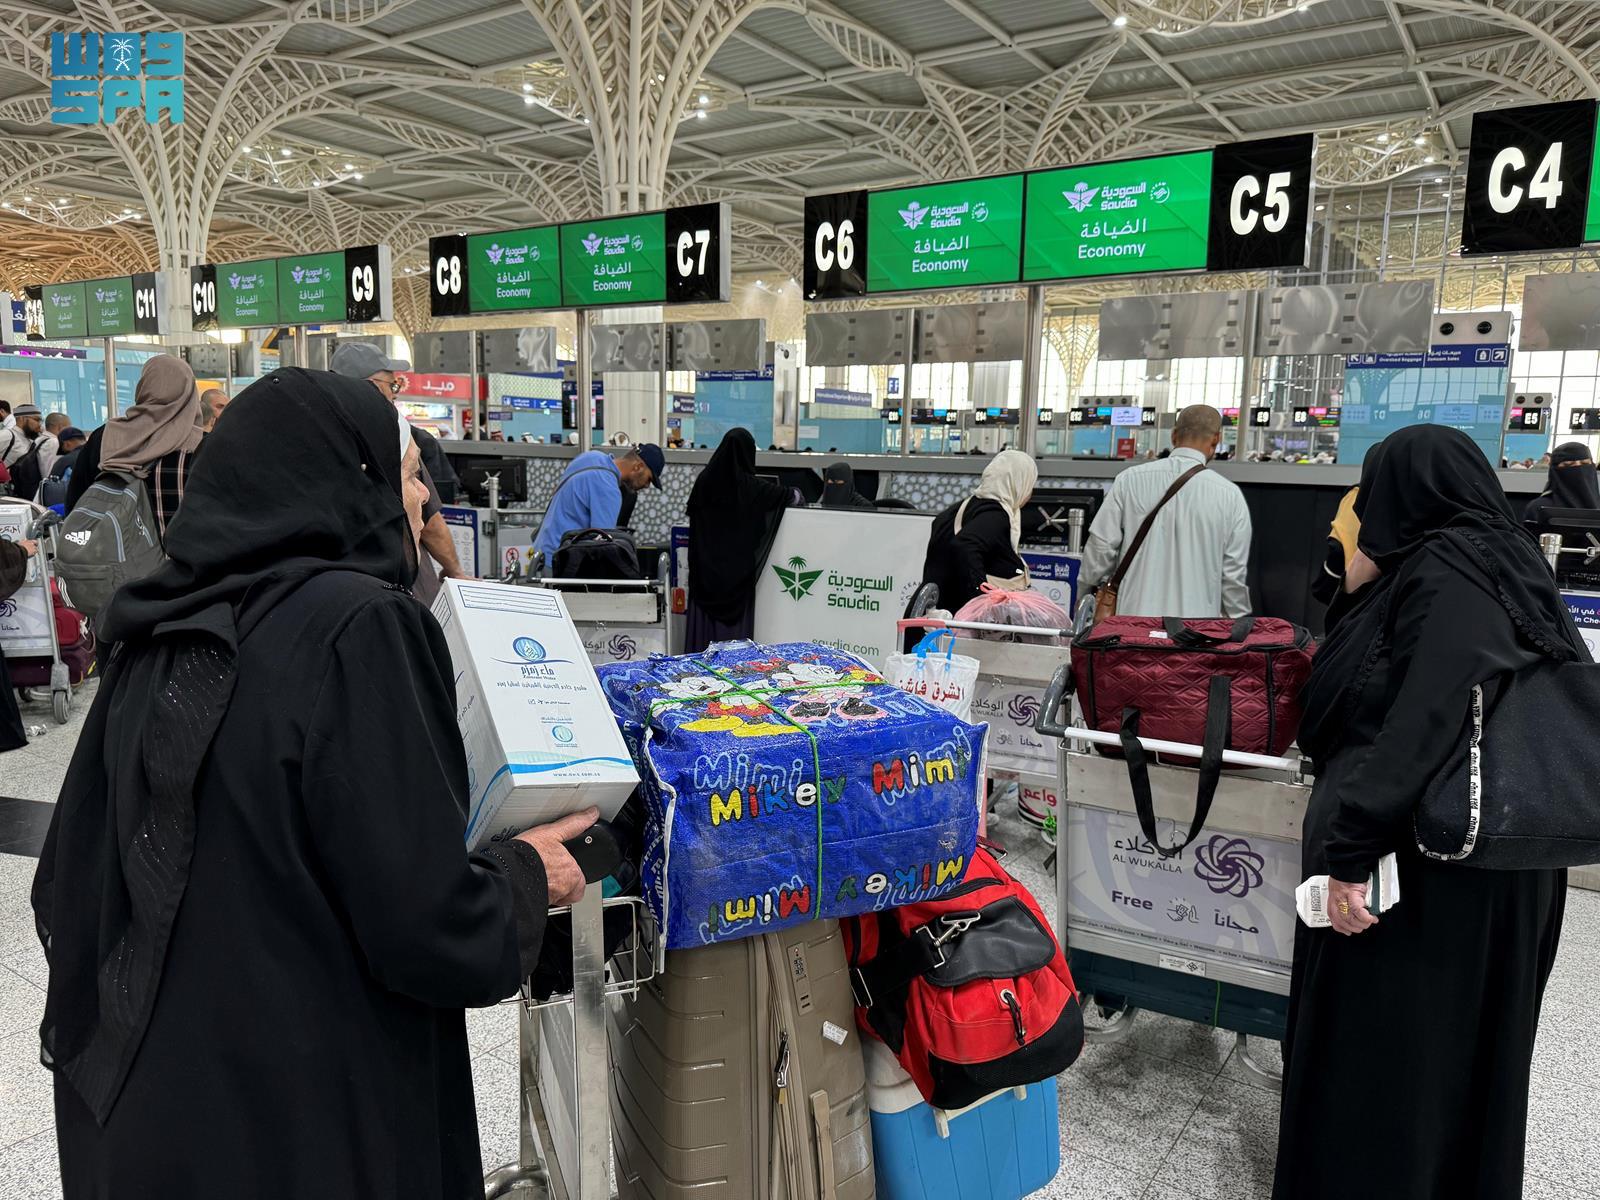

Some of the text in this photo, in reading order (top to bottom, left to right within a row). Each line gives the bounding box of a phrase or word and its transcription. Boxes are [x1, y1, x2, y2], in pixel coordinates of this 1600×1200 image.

[1488, 142, 1564, 214] C4
[1101, 182, 1147, 197] السعودية
[931, 202, 969, 216] السعودية
[1101, 197, 1138, 211] Saudia
[1230, 171, 1292, 236] C5
[930, 217, 961, 229] Saudia
[1080, 218, 1147, 239] الضيافة
[677, 229, 711, 278] C7
[815, 219, 855, 272] C6
[914, 236, 969, 255] الضيافة
[1078, 242, 1146, 259] Economy
[593, 262, 632, 276] الضيافة
[912, 258, 969, 273] Economy
[352, 265, 374, 302] C9
[436, 256, 462, 295] C8
[496, 271, 531, 284] الضيافة
[496, 287, 531, 299] Economy
[593, 279, 632, 292] Economy
[136, 288, 156, 319] C11
[192, 281, 216, 315] C10
[299, 303, 325, 312] Economy
[235, 308, 258, 317] Economy
[1524, 413, 1538, 424] E5
[1572, 413, 1586, 424] E4
[828, 570, 893, 593] السعودية
[827, 593, 880, 611] Saudia
[932, 681, 965, 702] الشرق
[710, 775, 847, 826] Mikey
[1112, 854, 1183, 874] AL WUKALLA
[836, 854, 965, 901] Mikey
[1111, 890, 1153, 911] Free
